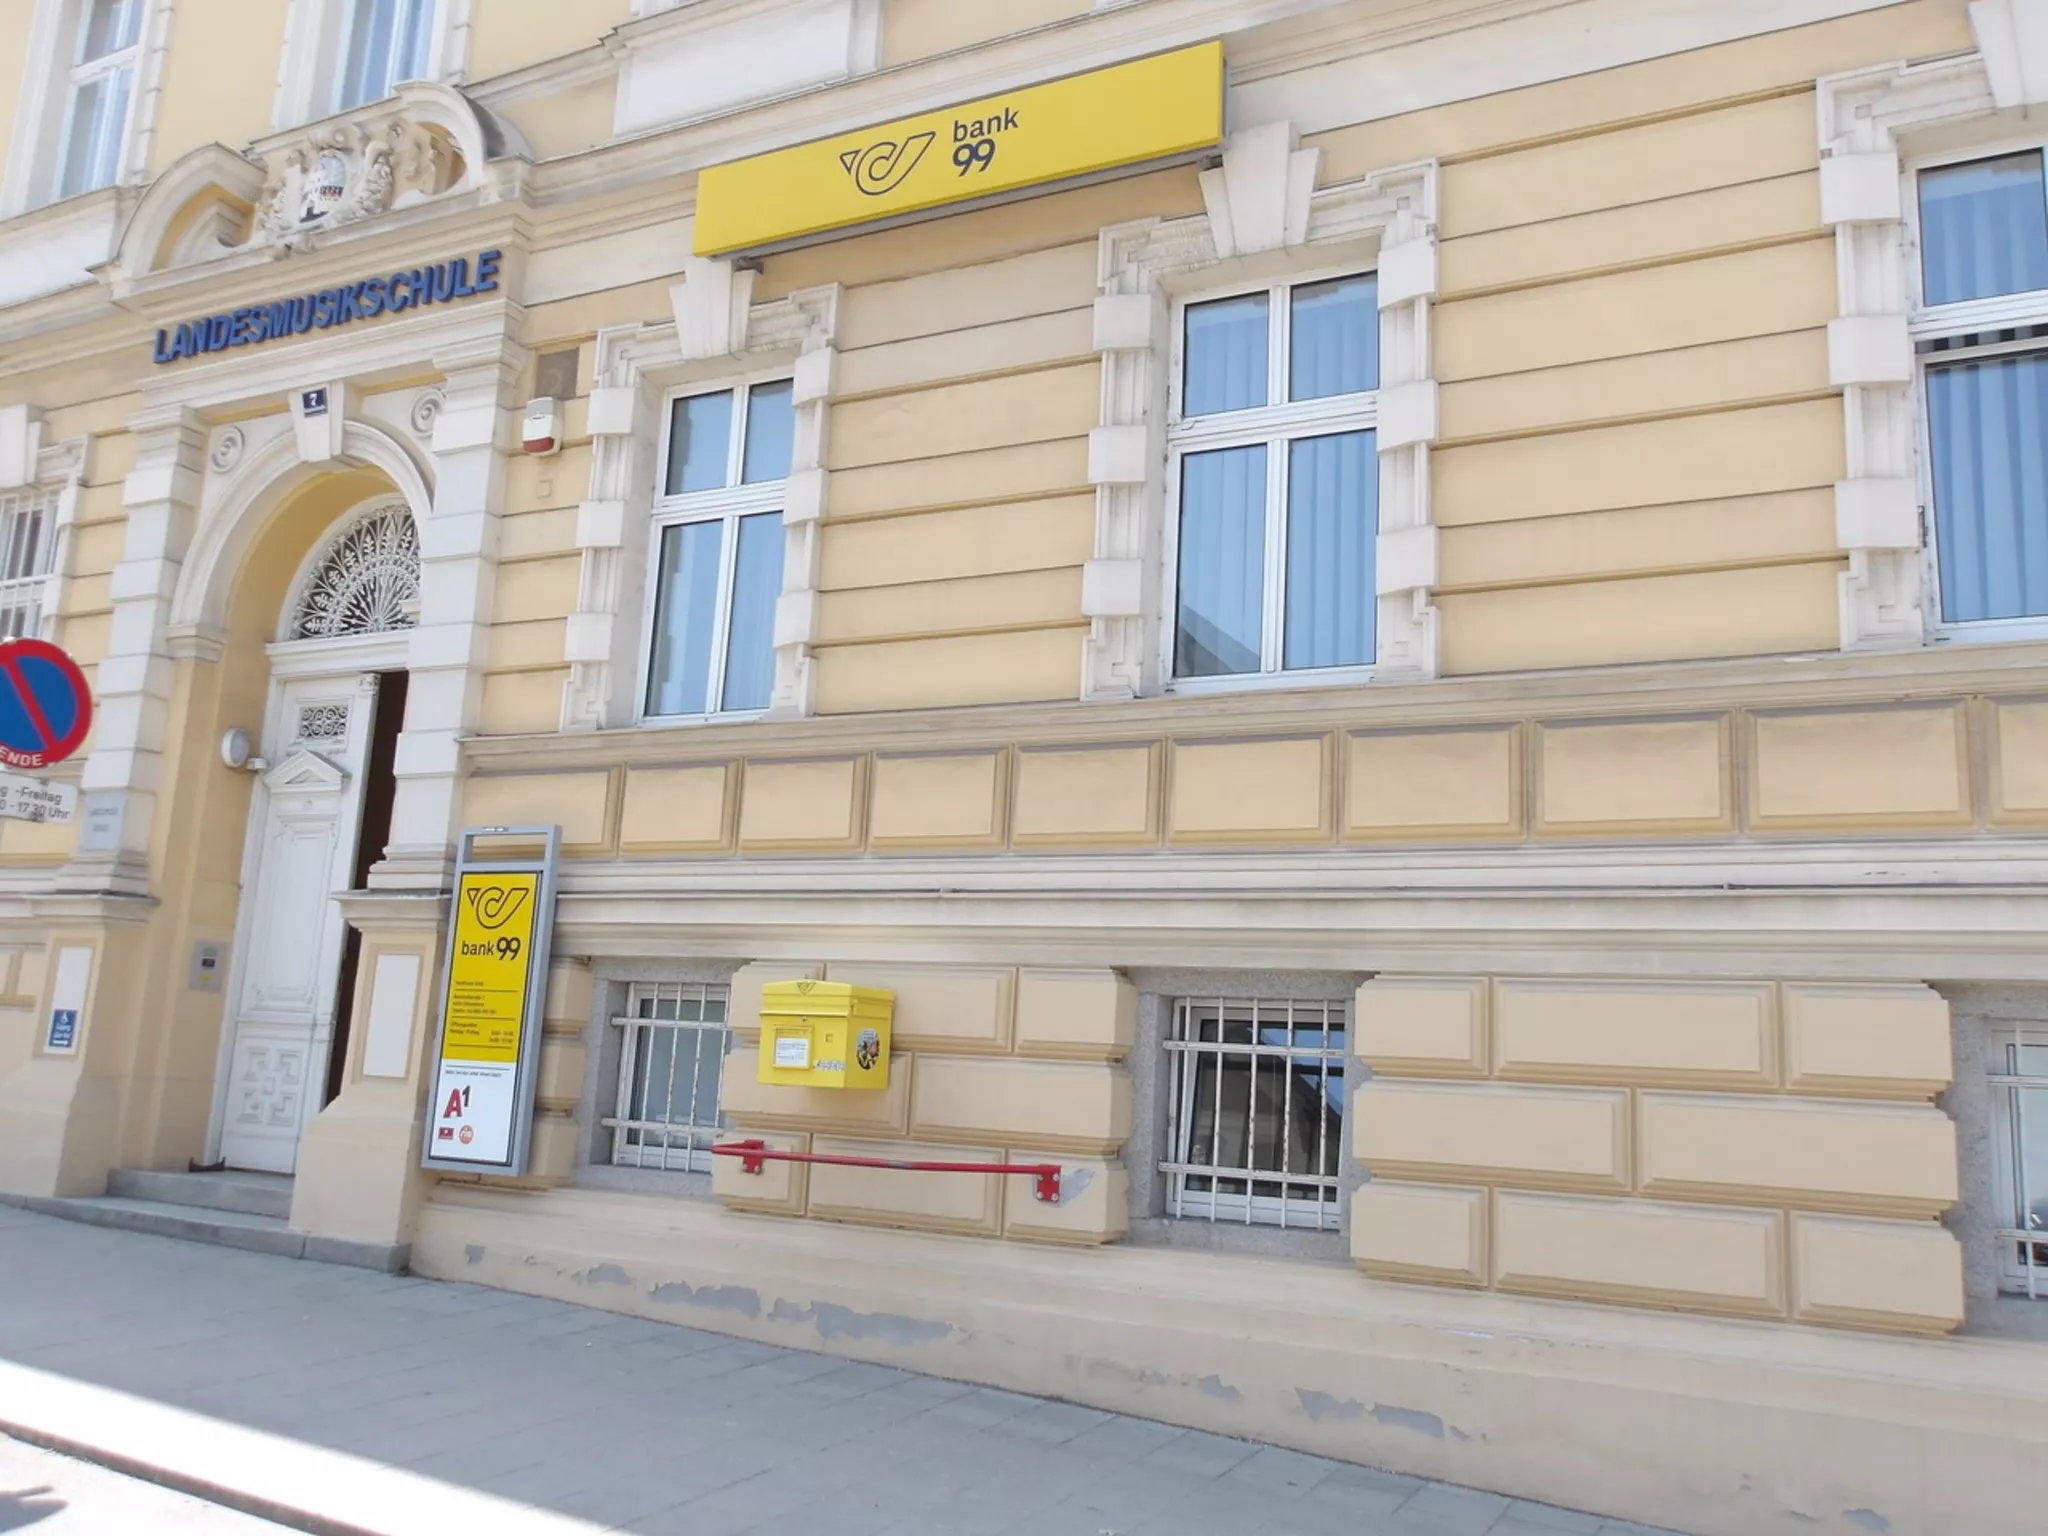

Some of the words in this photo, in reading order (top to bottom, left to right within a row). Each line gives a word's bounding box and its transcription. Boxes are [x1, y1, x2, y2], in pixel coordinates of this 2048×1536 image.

[953, 107, 1019, 142] bank
[952, 138, 996, 177] 99
[153, 250, 502, 364] LANDESMUSIKSCHULE
[309, 392, 318, 406] 7
[0, 745, 43, 766] ENDE
[48, 806, 71, 819] Uhr
[443, 1085, 471, 1118] A1
